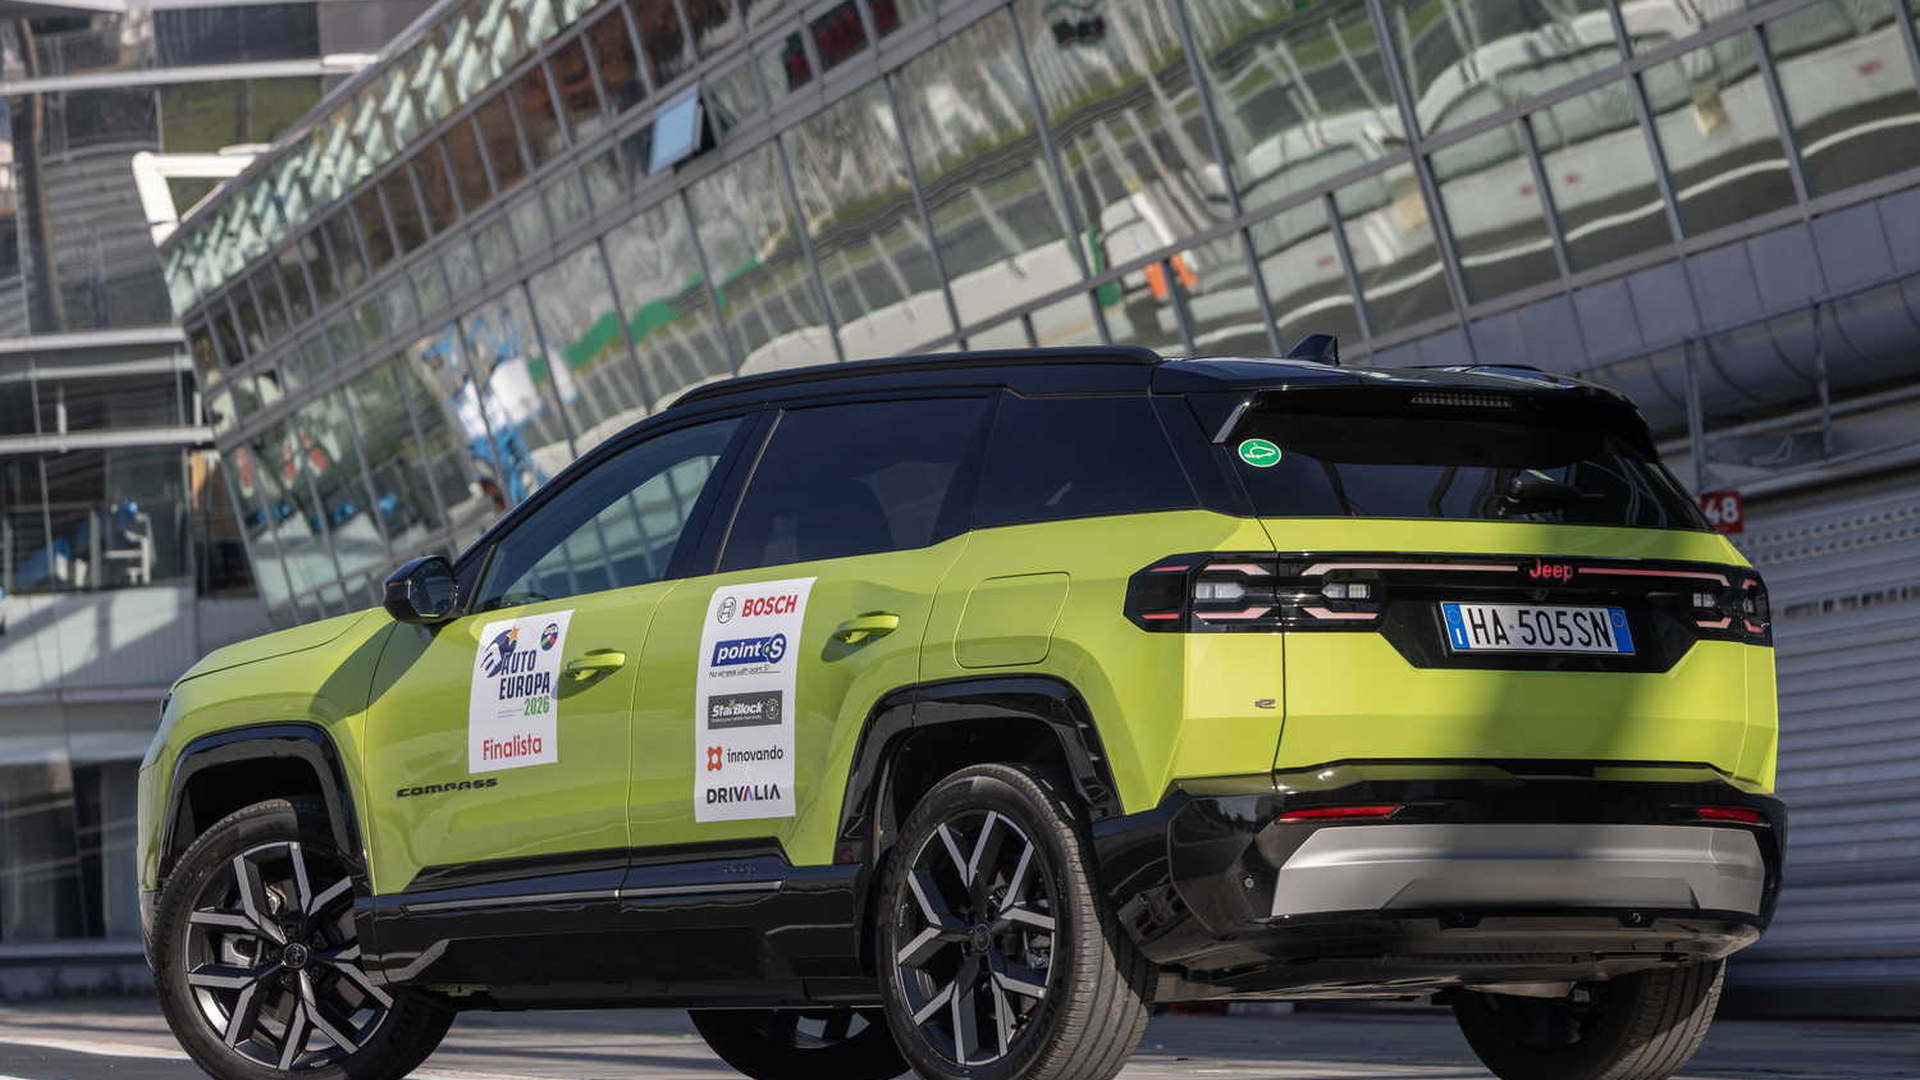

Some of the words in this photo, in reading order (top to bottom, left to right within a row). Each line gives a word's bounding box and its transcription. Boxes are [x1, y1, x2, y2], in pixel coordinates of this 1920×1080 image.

[1704, 497, 1739, 525] 48
[1529, 559, 1574, 582] Jeep
[742, 595, 798, 617] BOSCH
[1518, 609, 1613, 648] 505SN
[500, 650, 537, 676] AUTO
[499, 671, 550, 700] EUROPA
[524, 696, 550, 716] 2026
[483, 733, 543, 760] Finalista
[727, 745, 783, 762] innovando
[706, 783, 781, 804] DRIVALIA
